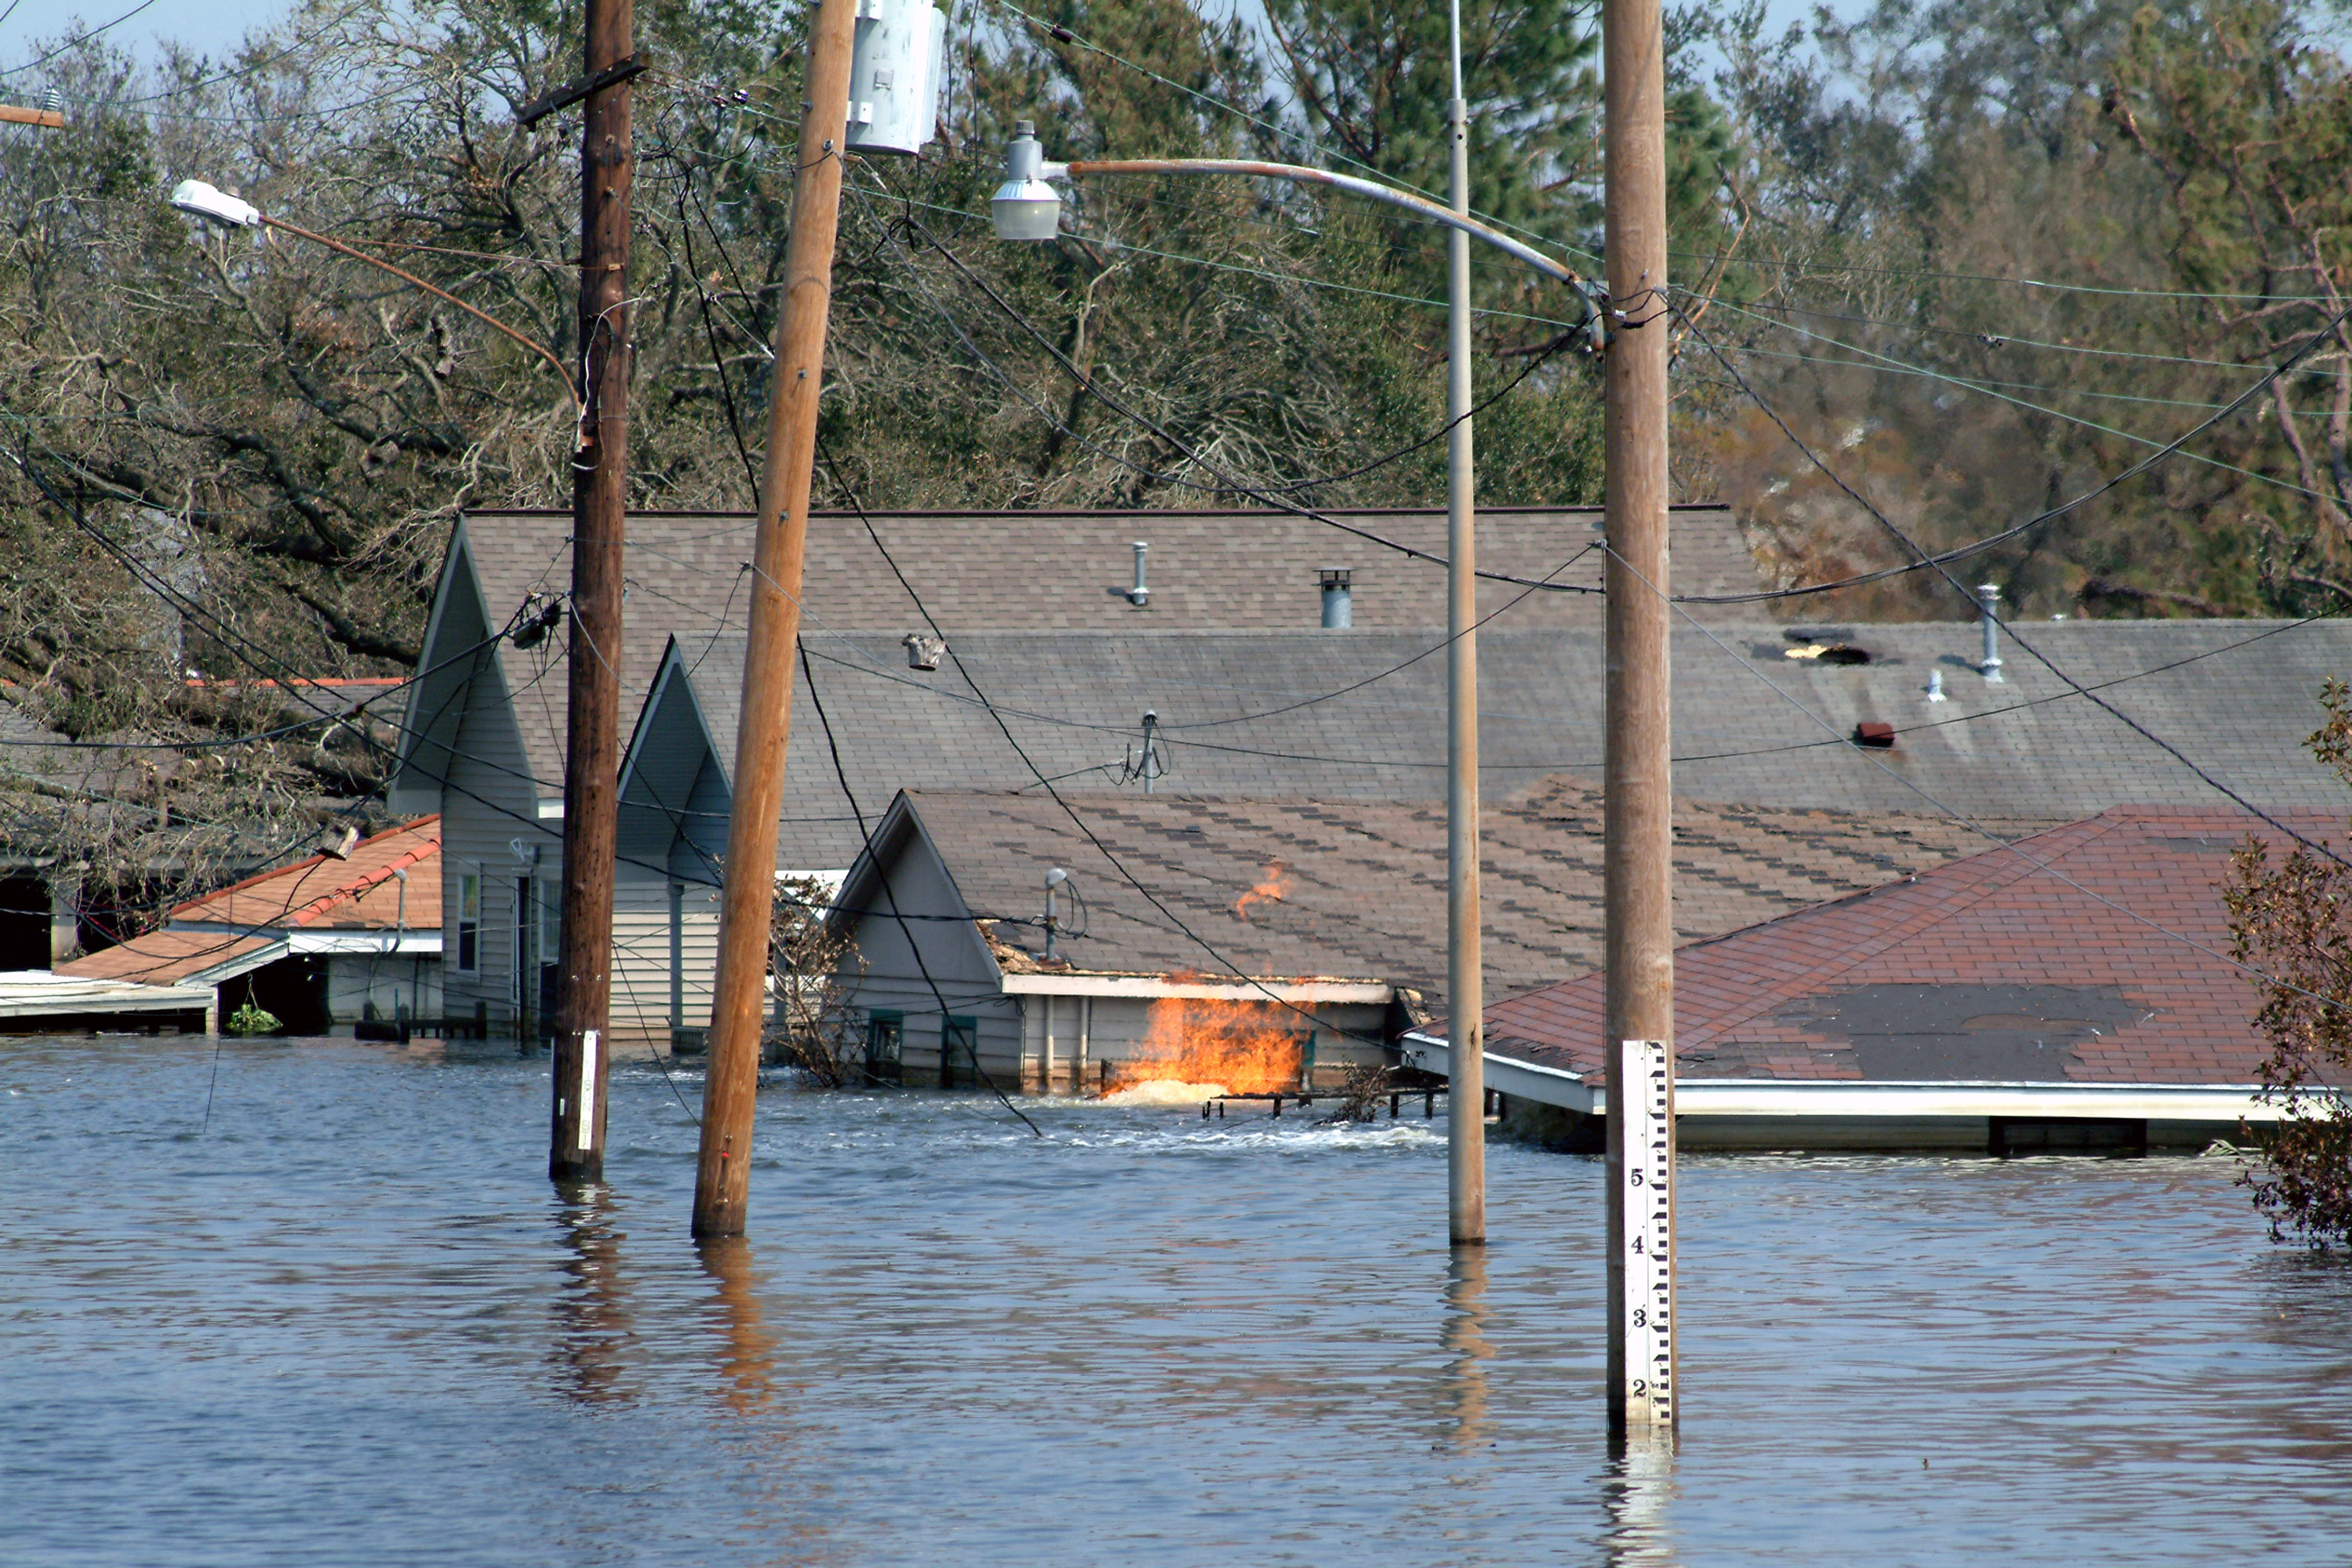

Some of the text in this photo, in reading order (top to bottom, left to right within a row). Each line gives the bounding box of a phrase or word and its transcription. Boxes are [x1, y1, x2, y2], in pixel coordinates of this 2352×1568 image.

[1631, 1168, 1644, 1186] 5
[1631, 1236, 1644, 1254] 4
[1633, 1309, 1646, 1328] 3
[1633, 1379, 1646, 1398] 2
